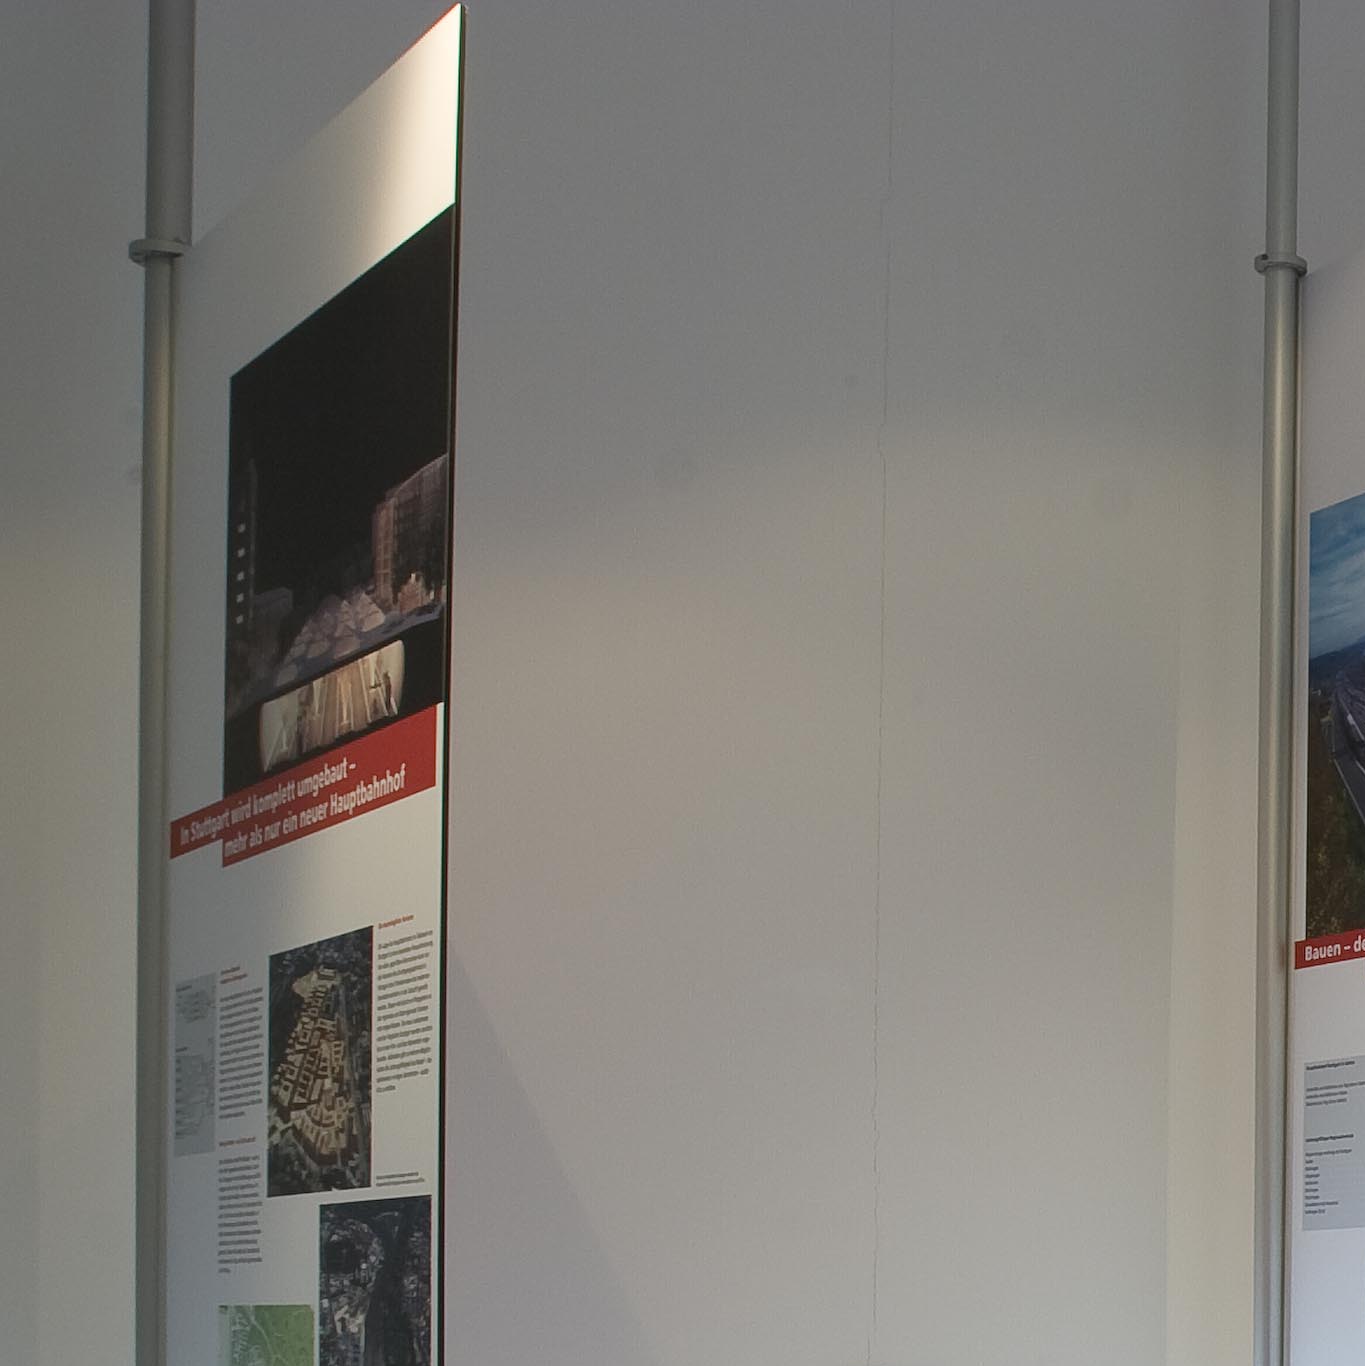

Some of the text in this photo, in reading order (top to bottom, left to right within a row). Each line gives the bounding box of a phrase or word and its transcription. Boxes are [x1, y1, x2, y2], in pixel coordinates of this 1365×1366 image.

[190, 808, 230, 842] Stuttgart
[231, 796, 251, 824] wird
[253, 780, 295, 815] komplett
[297, 757, 347, 797] umgebaut
[224, 763, 406, 857] mehr als nur ein neuer Hauptbahnhof
[1305, 943, 1341, 961] Bauen
